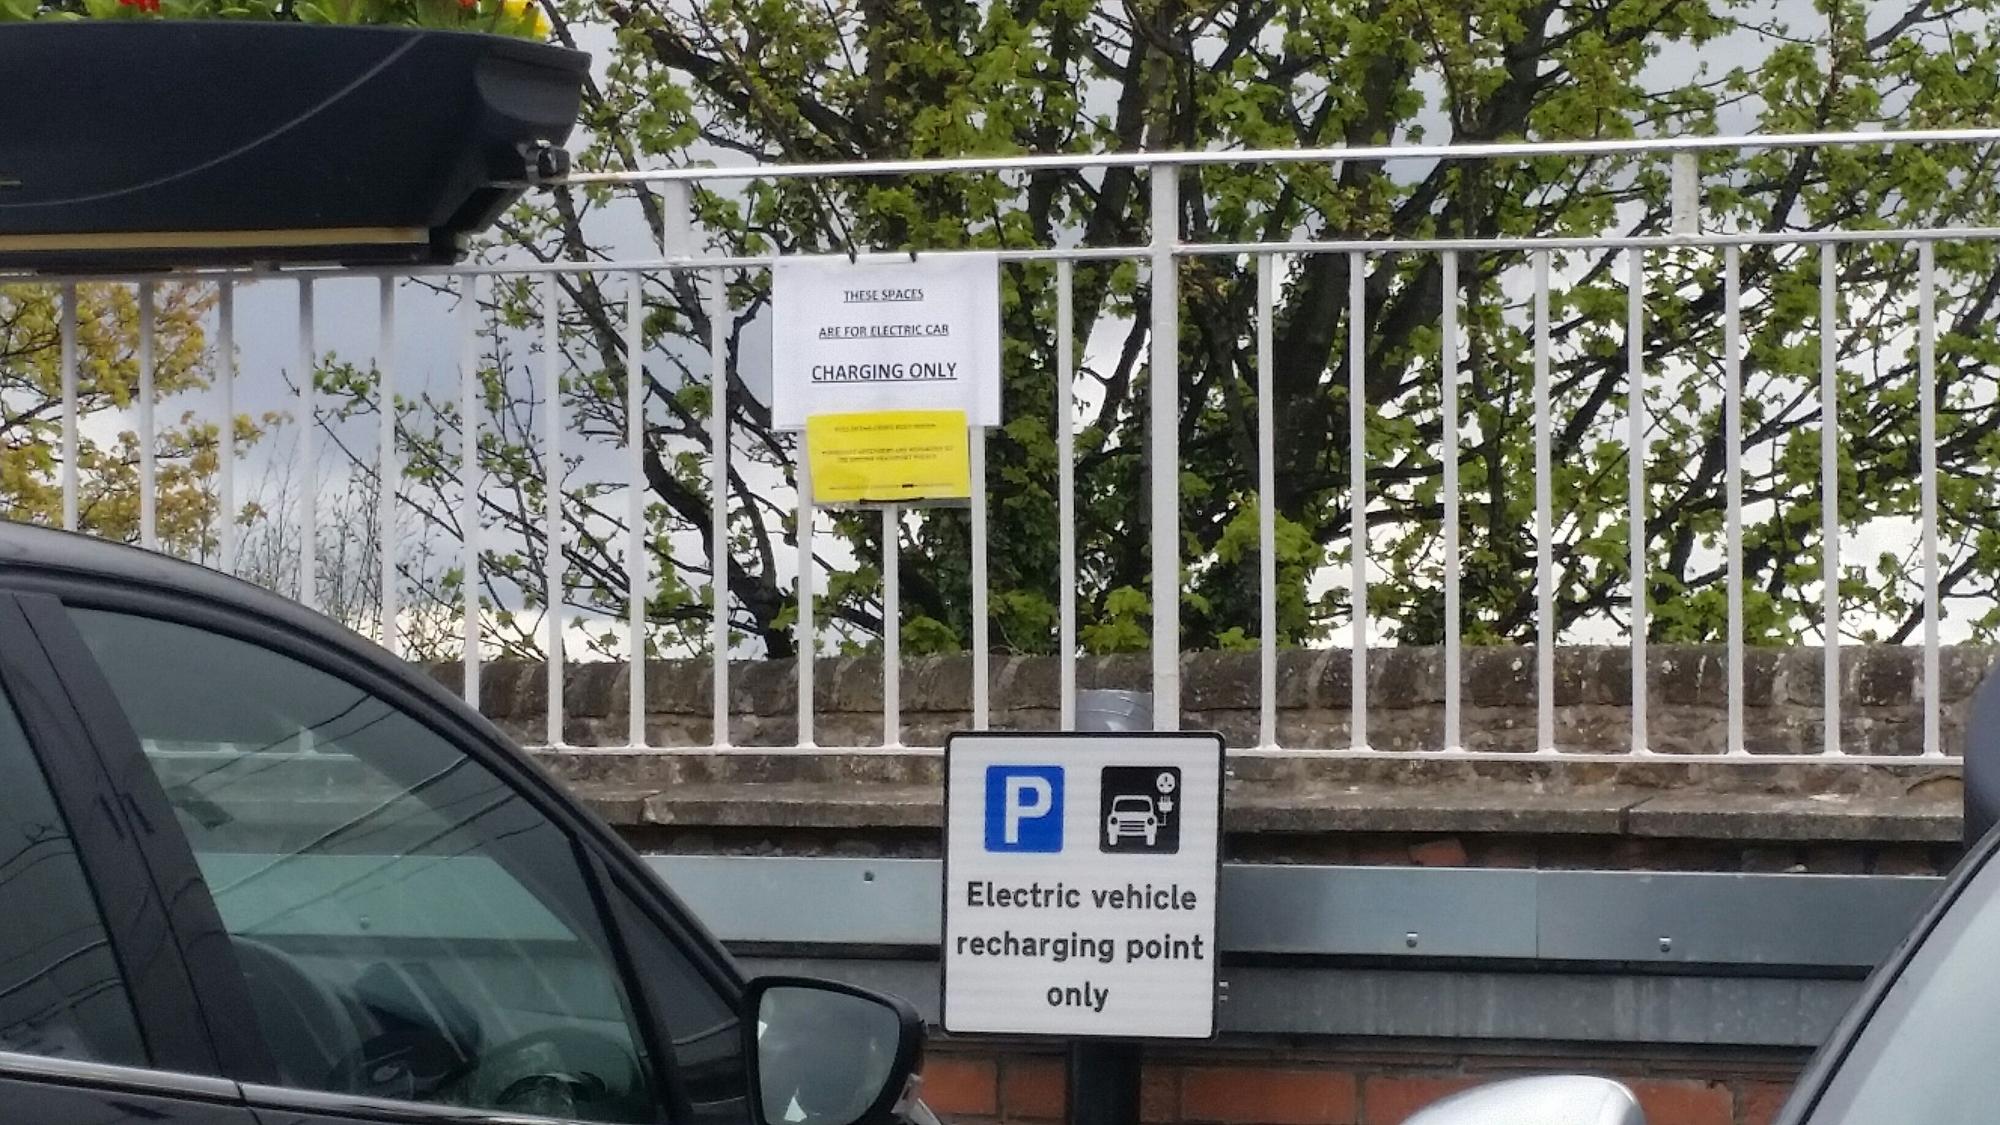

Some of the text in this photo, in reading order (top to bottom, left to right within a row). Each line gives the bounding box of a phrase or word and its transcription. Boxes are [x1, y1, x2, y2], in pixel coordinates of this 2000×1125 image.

[844, 289, 924, 302] THESE SPACES
[819, 324, 949, 338] ARE FOR ELECTRIC CAR
[812, 363, 957, 381] CHARGING ONLY
[1004, 776, 1052, 844] P
[968, 881, 1197, 910] Electric vehicle
[957, 932, 1204, 963] recharging point
[1047, 982, 1109, 1012] only
